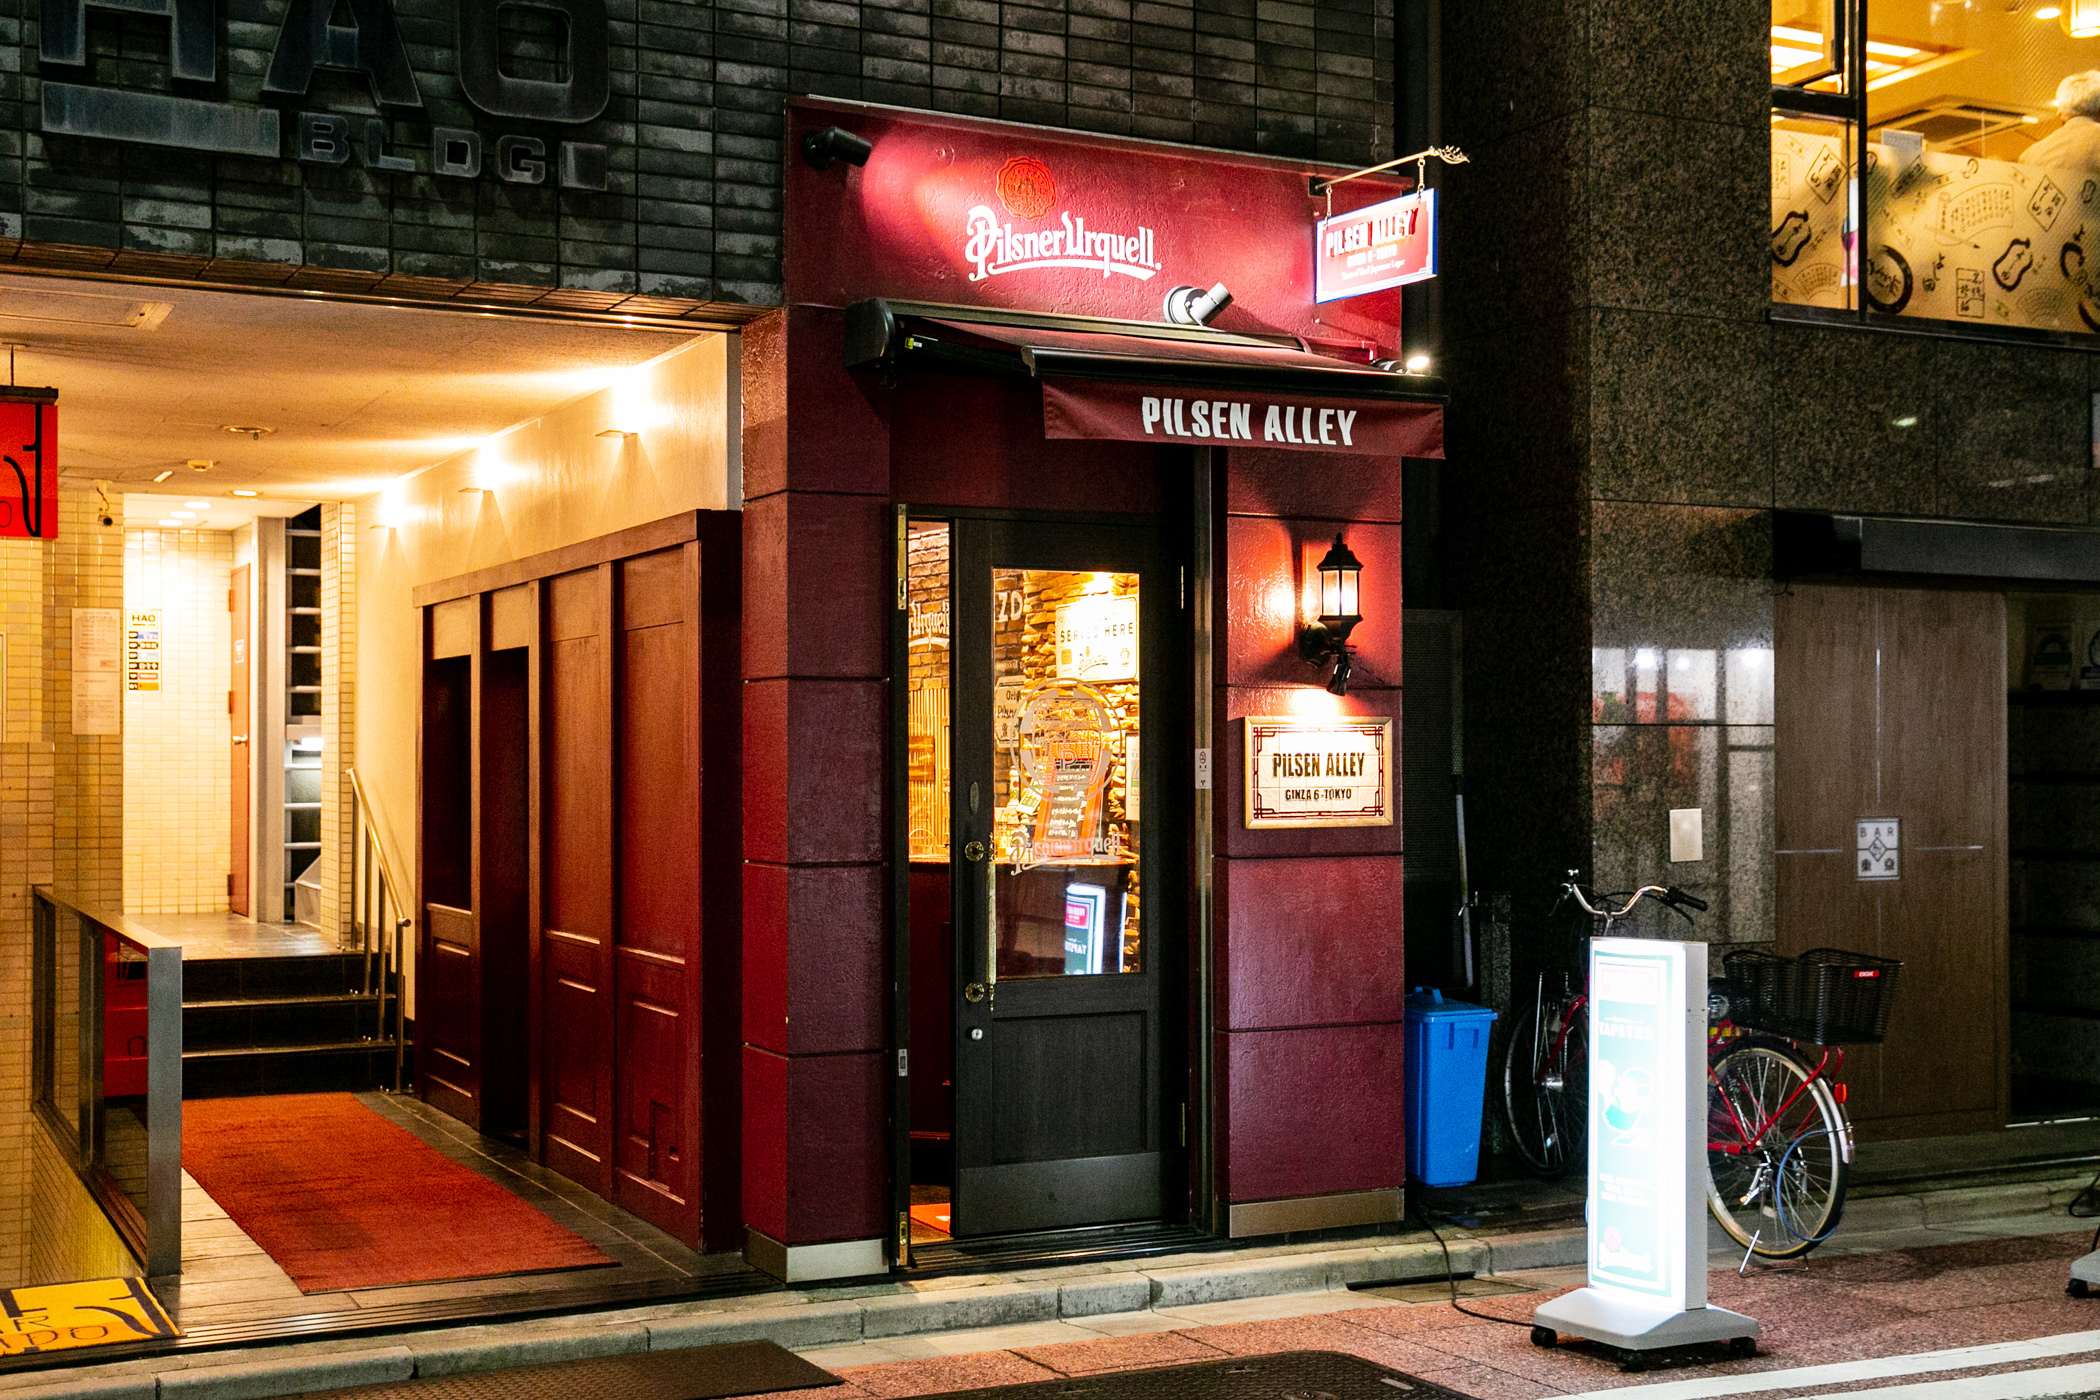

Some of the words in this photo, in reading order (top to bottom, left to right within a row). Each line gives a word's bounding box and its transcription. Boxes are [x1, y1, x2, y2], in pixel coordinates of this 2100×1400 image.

[299, 111, 546, 185] BLDG
[1326, 221, 1373, 258] PILSEN
[1372, 207, 1419, 246] ALLEY
[1142, 396, 1252, 440] PILSEN
[1264, 405, 1357, 446] ALLEY
[132, 614, 156, 622] HAO
[1104, 622, 1134, 638] HERE
[1273, 753, 1321, 778] PILSEN
[1325, 752, 1365, 777] ALLEY
[1285, 789, 1312, 801] GINZA
